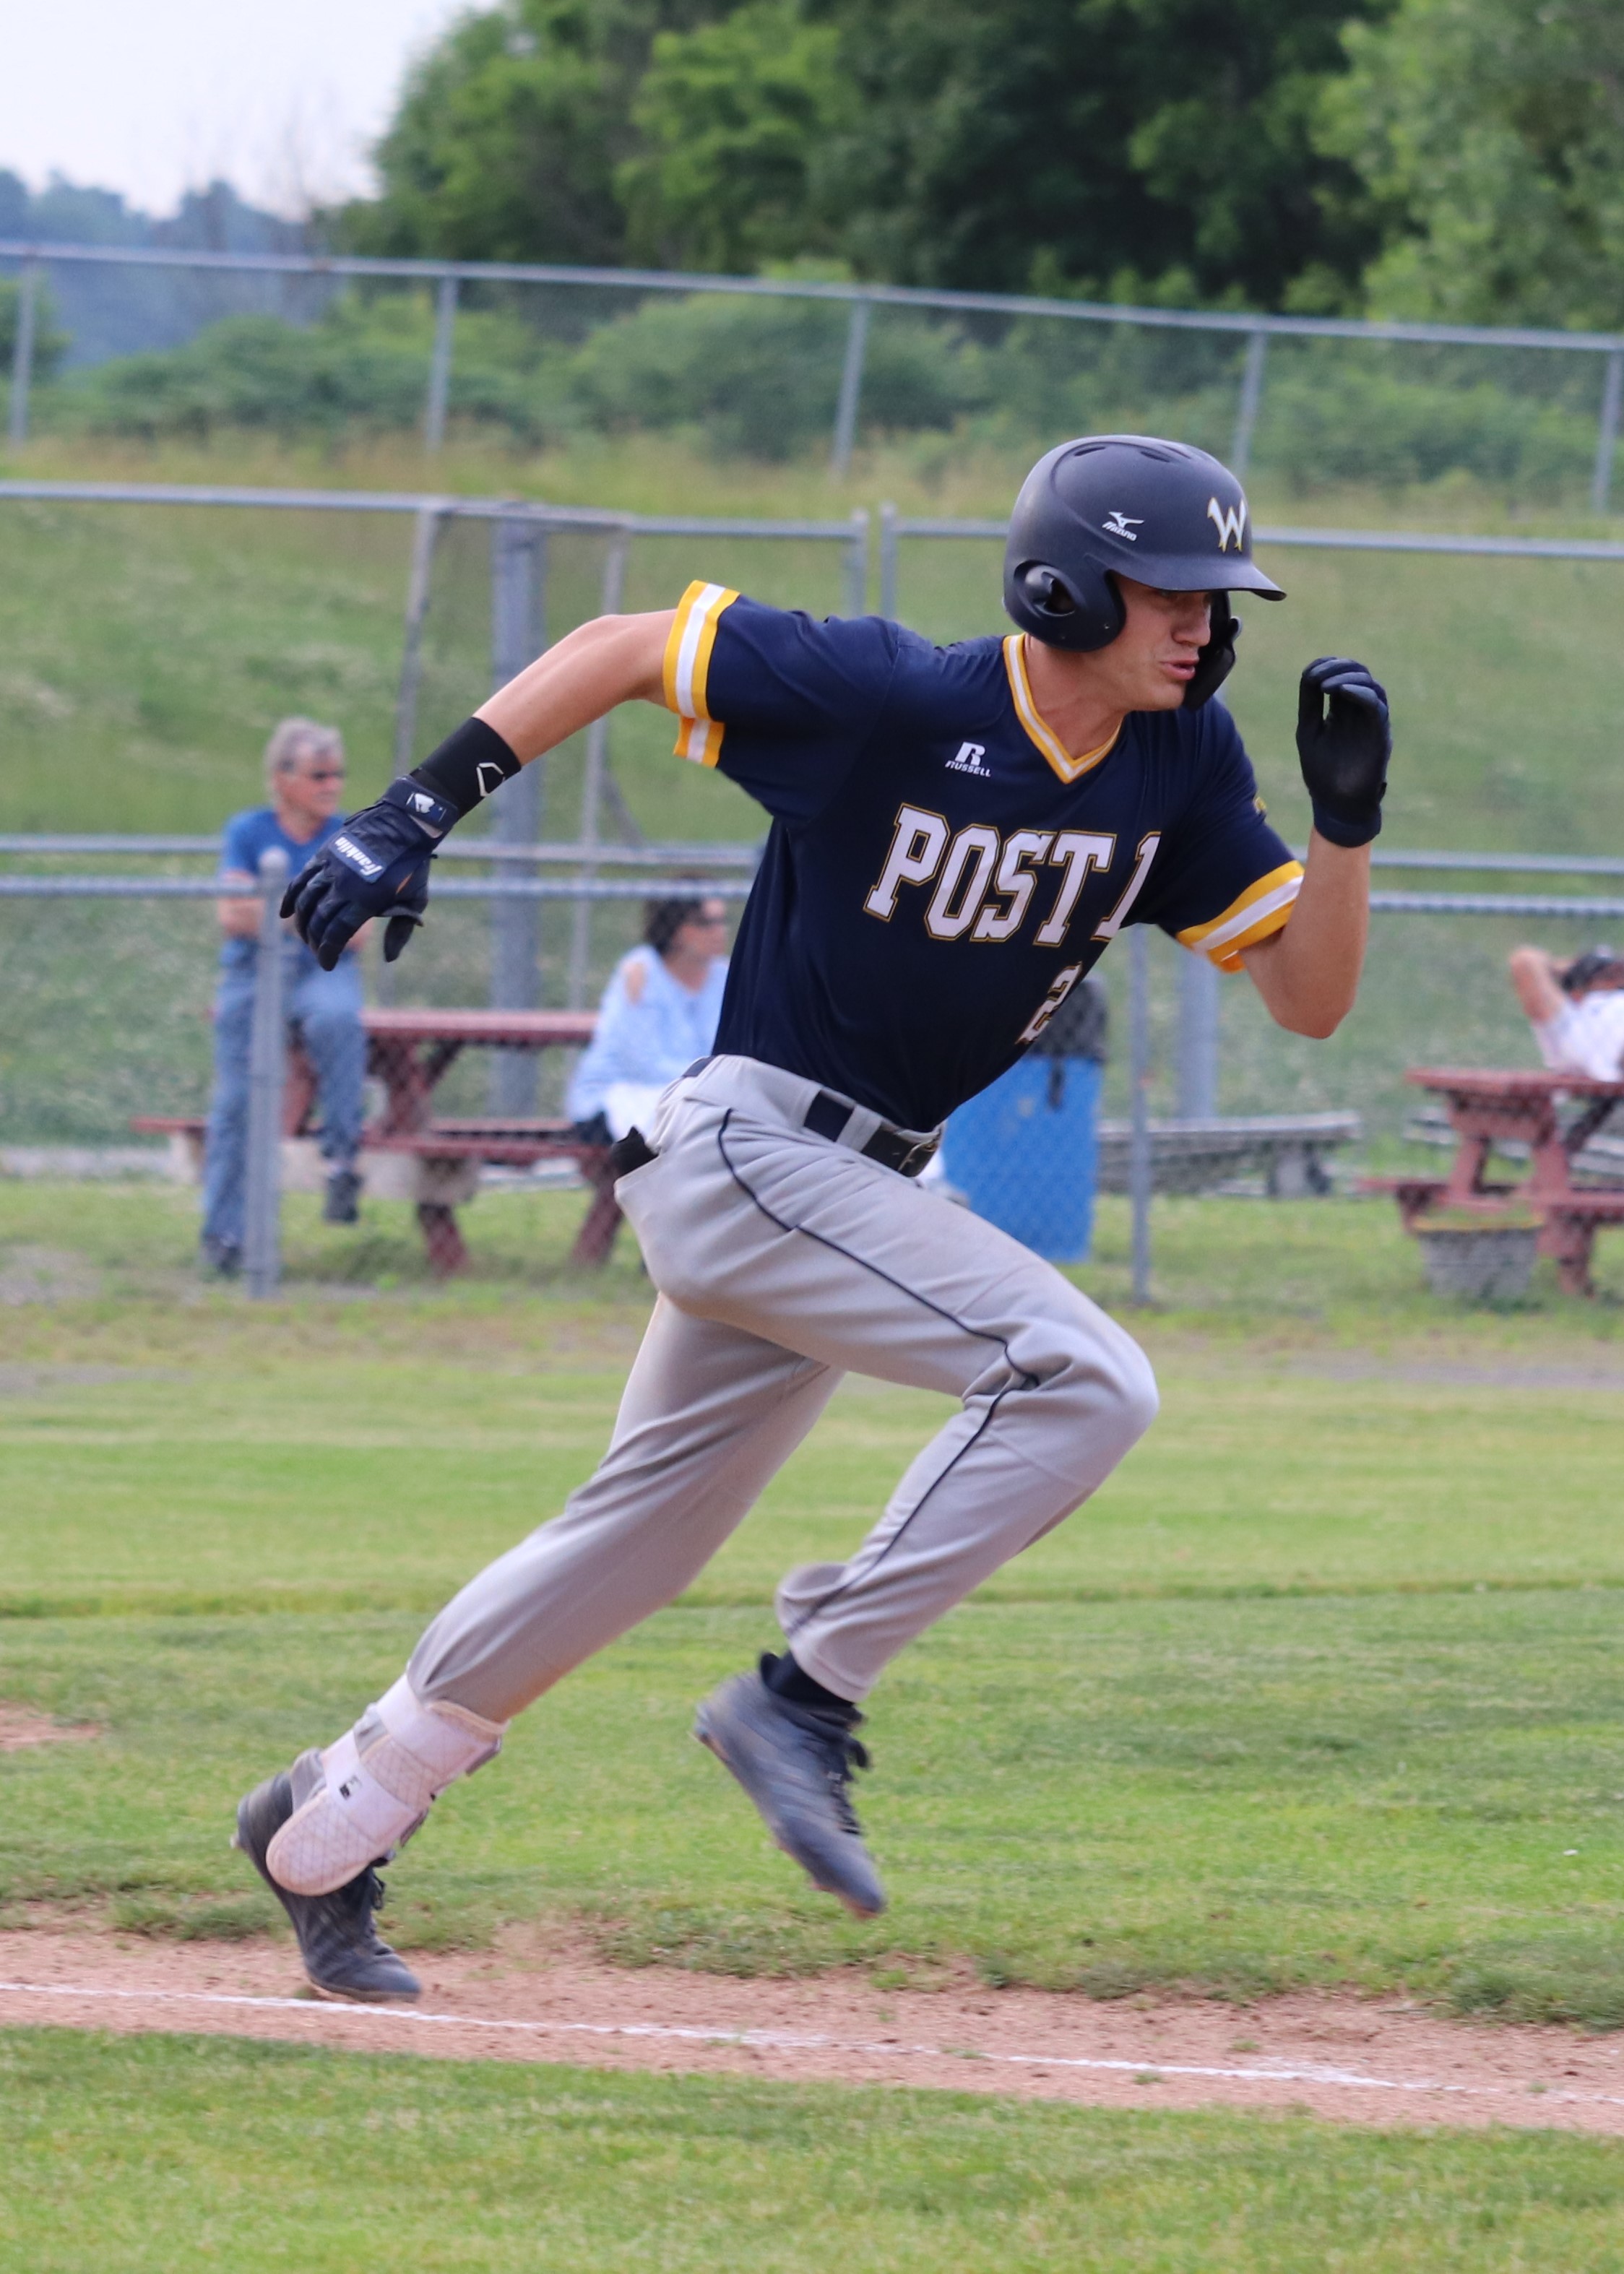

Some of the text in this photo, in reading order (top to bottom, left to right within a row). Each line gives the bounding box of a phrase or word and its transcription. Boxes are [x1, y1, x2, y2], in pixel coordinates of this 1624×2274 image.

[1206, 496, 1247, 553] W
[945, 761, 991, 777] RUSSELL
[863, 803, 1118, 948] POST
